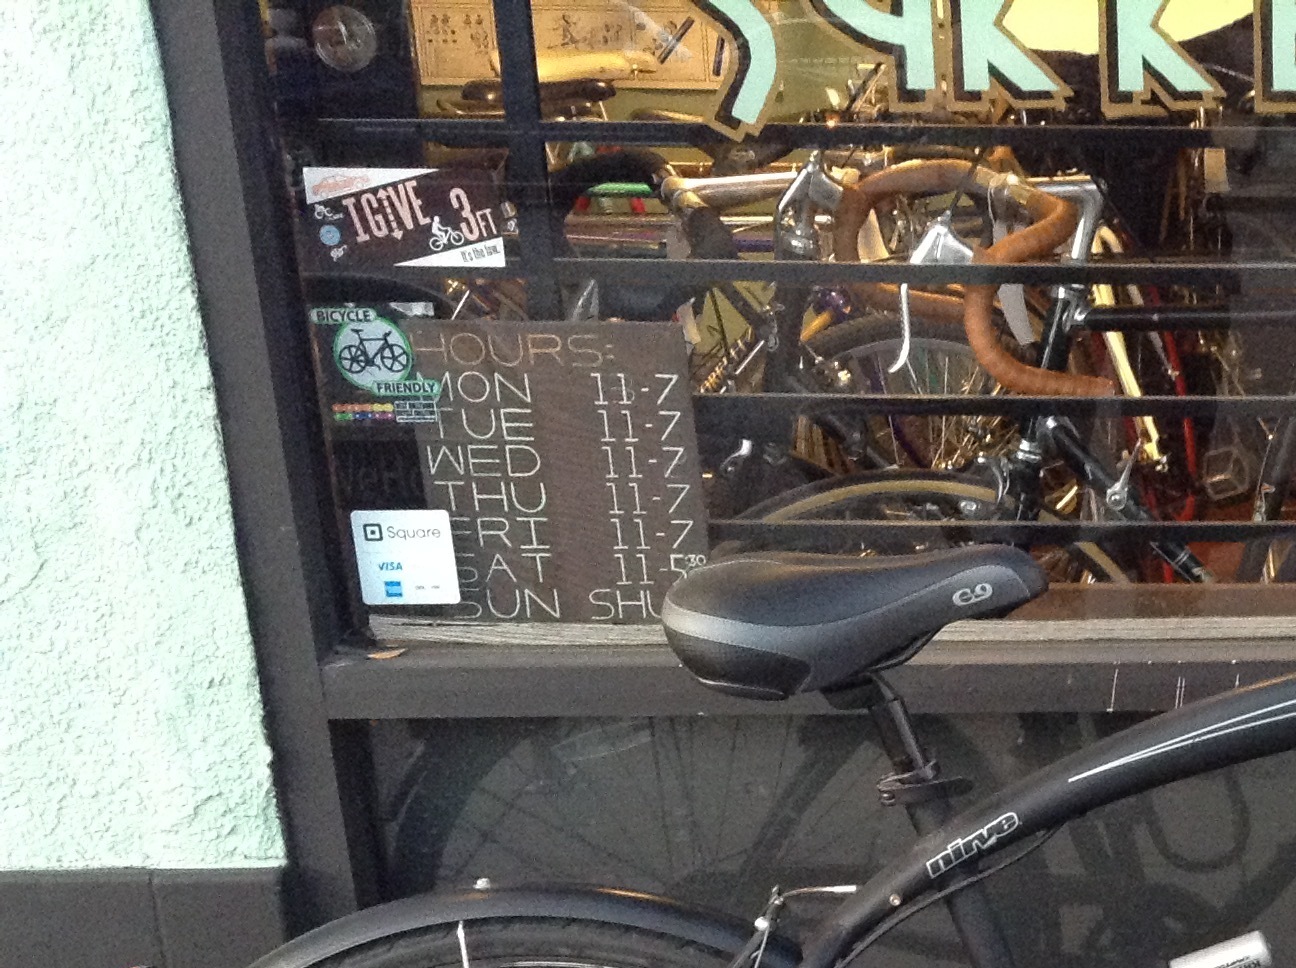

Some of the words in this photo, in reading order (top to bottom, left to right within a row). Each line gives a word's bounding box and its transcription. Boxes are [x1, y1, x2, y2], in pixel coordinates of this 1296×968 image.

[316, 311, 372, 322] BICYCLE
[410, 331, 615, 367] HOURS:
[377, 382, 436, 394] FRIENDLY
[416, 371, 532, 402] MON
[590, 372, 679, 405] 11-7
[436, 408, 535, 441] TUE
[597, 409, 682, 442] 11-7
[427, 445, 542, 477] WED
[601, 446, 685, 478] 11-7
[434, 481, 547, 513] THU
[606, 482, 691, 515] 11-7
[386, 526, 441, 540] Square
[609, 518, 694, 550] 11-7
[378, 562, 403, 572] VISA
